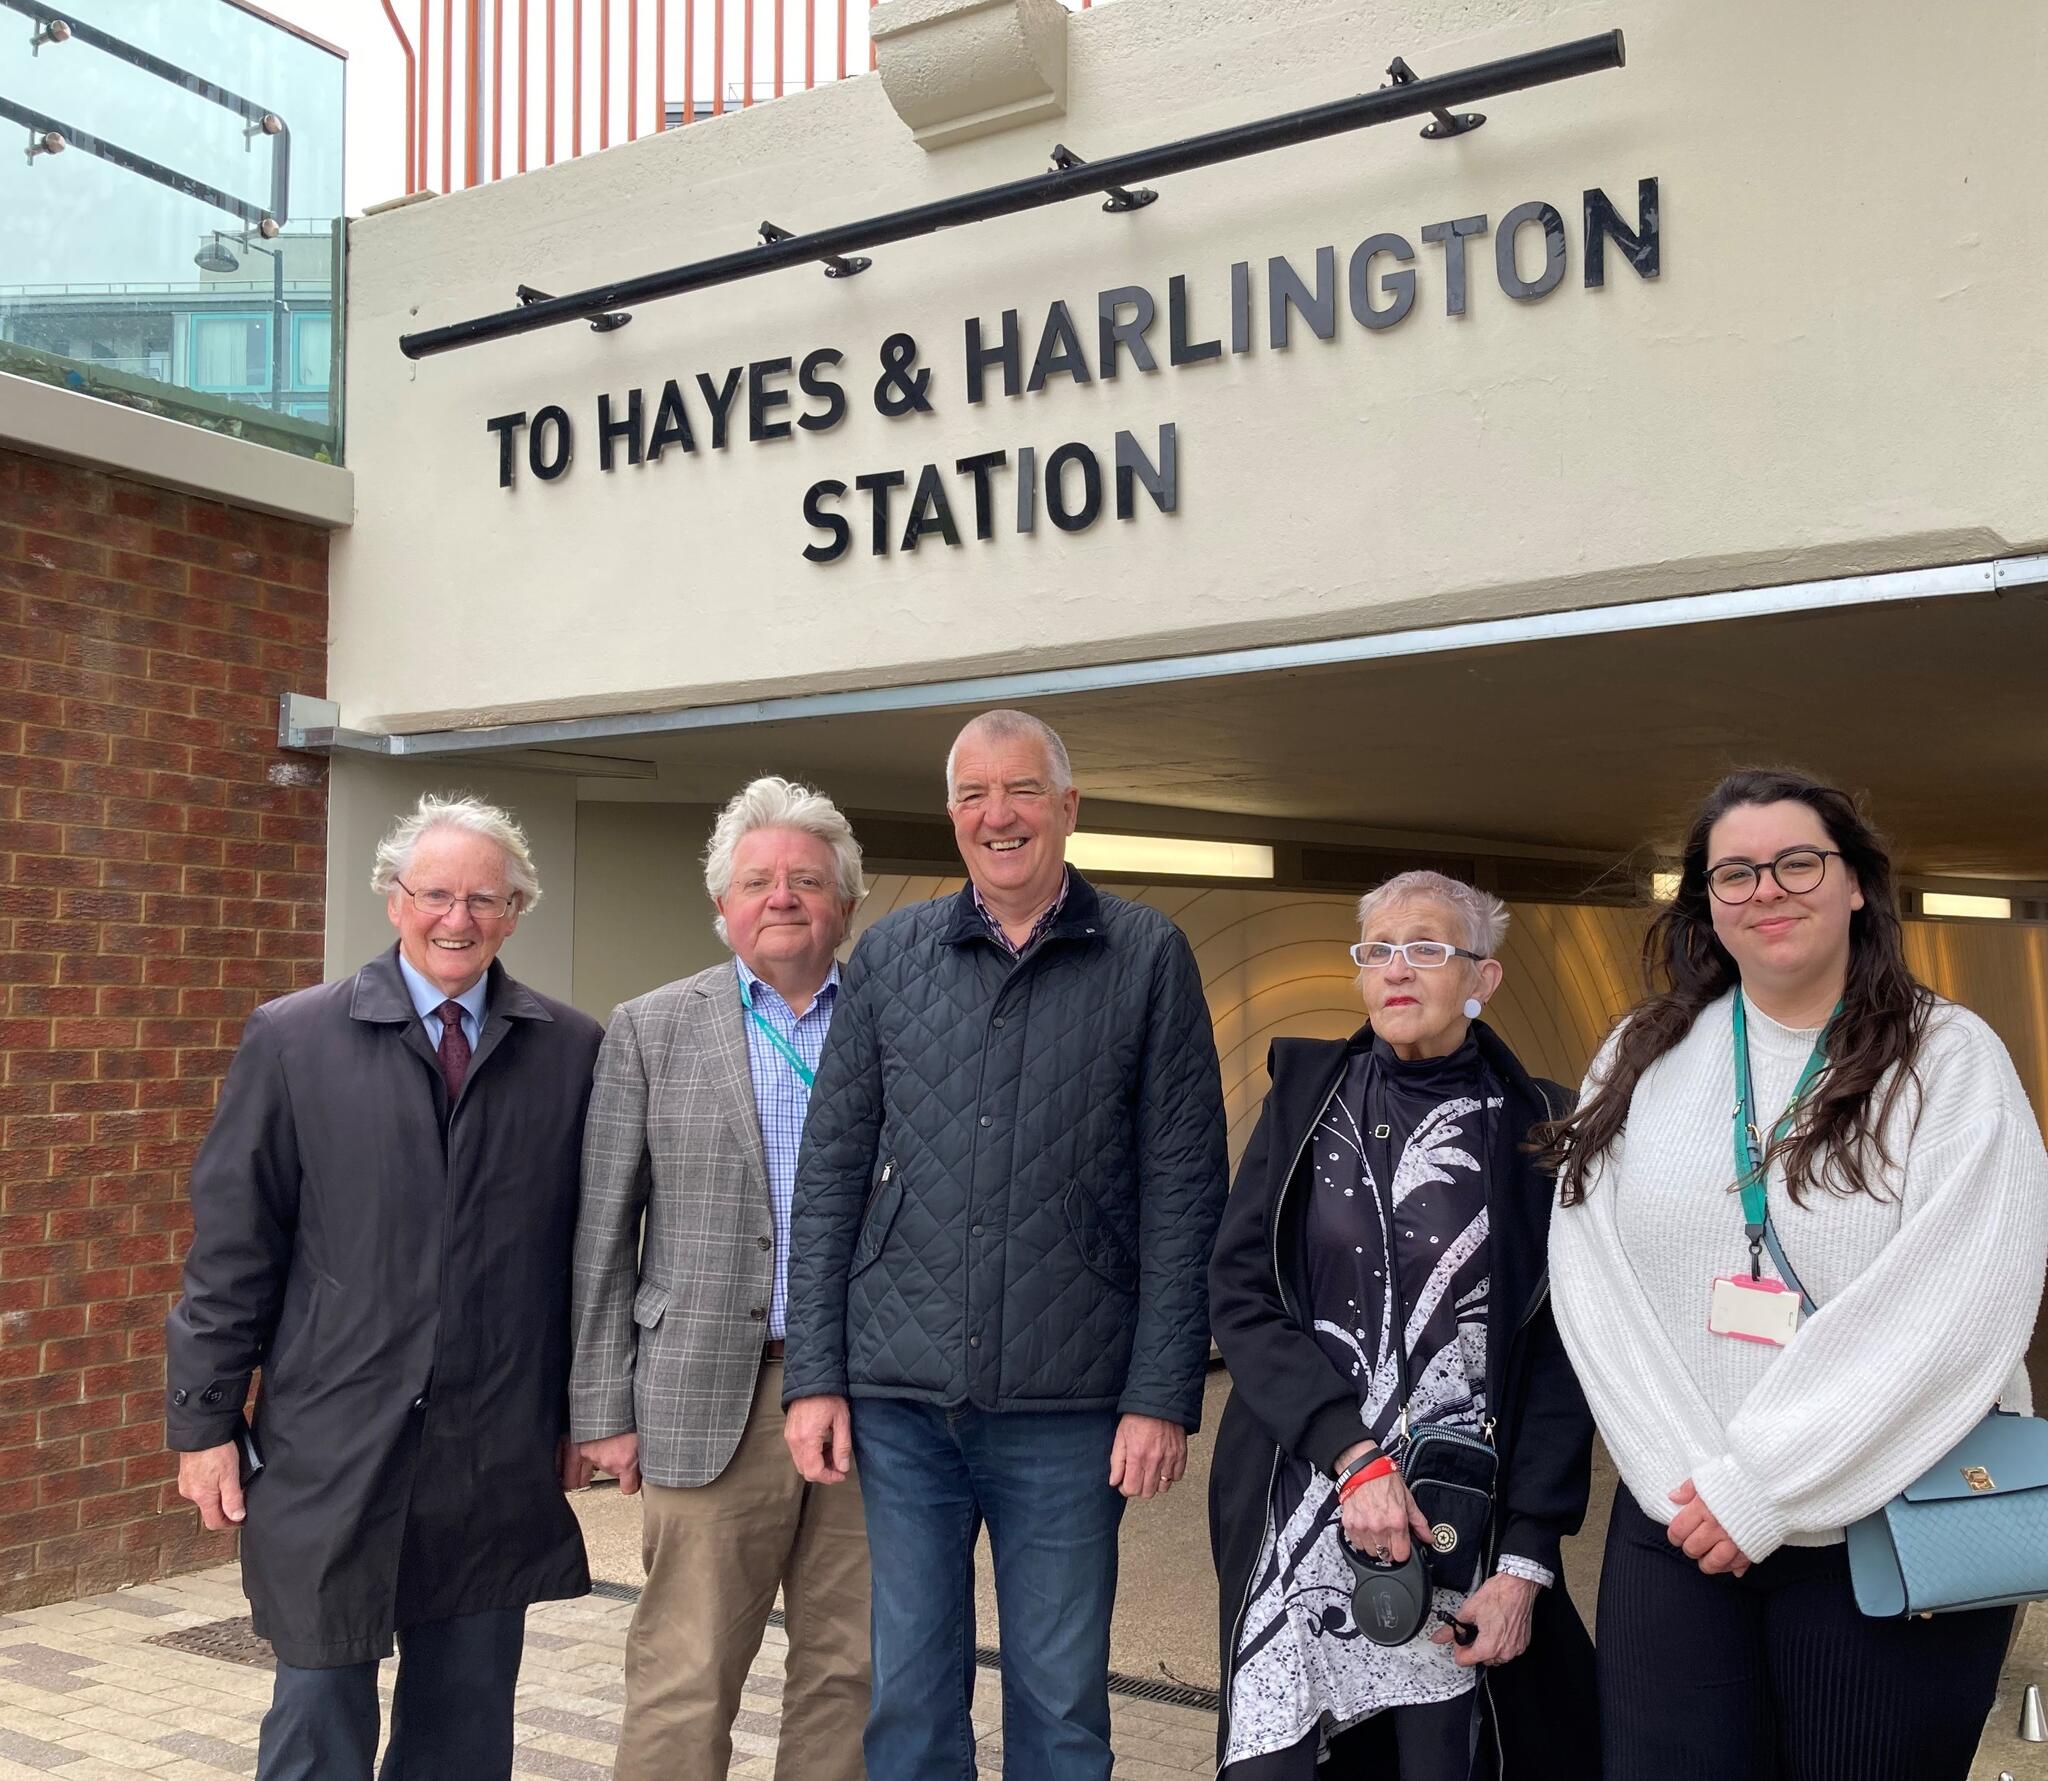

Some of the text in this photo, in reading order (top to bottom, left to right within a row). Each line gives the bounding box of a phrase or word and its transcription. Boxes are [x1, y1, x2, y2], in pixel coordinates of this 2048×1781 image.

[486, 176, 1661, 491] TO HAYES & HARLINGTON
[801, 422, 1179, 566] STATION
